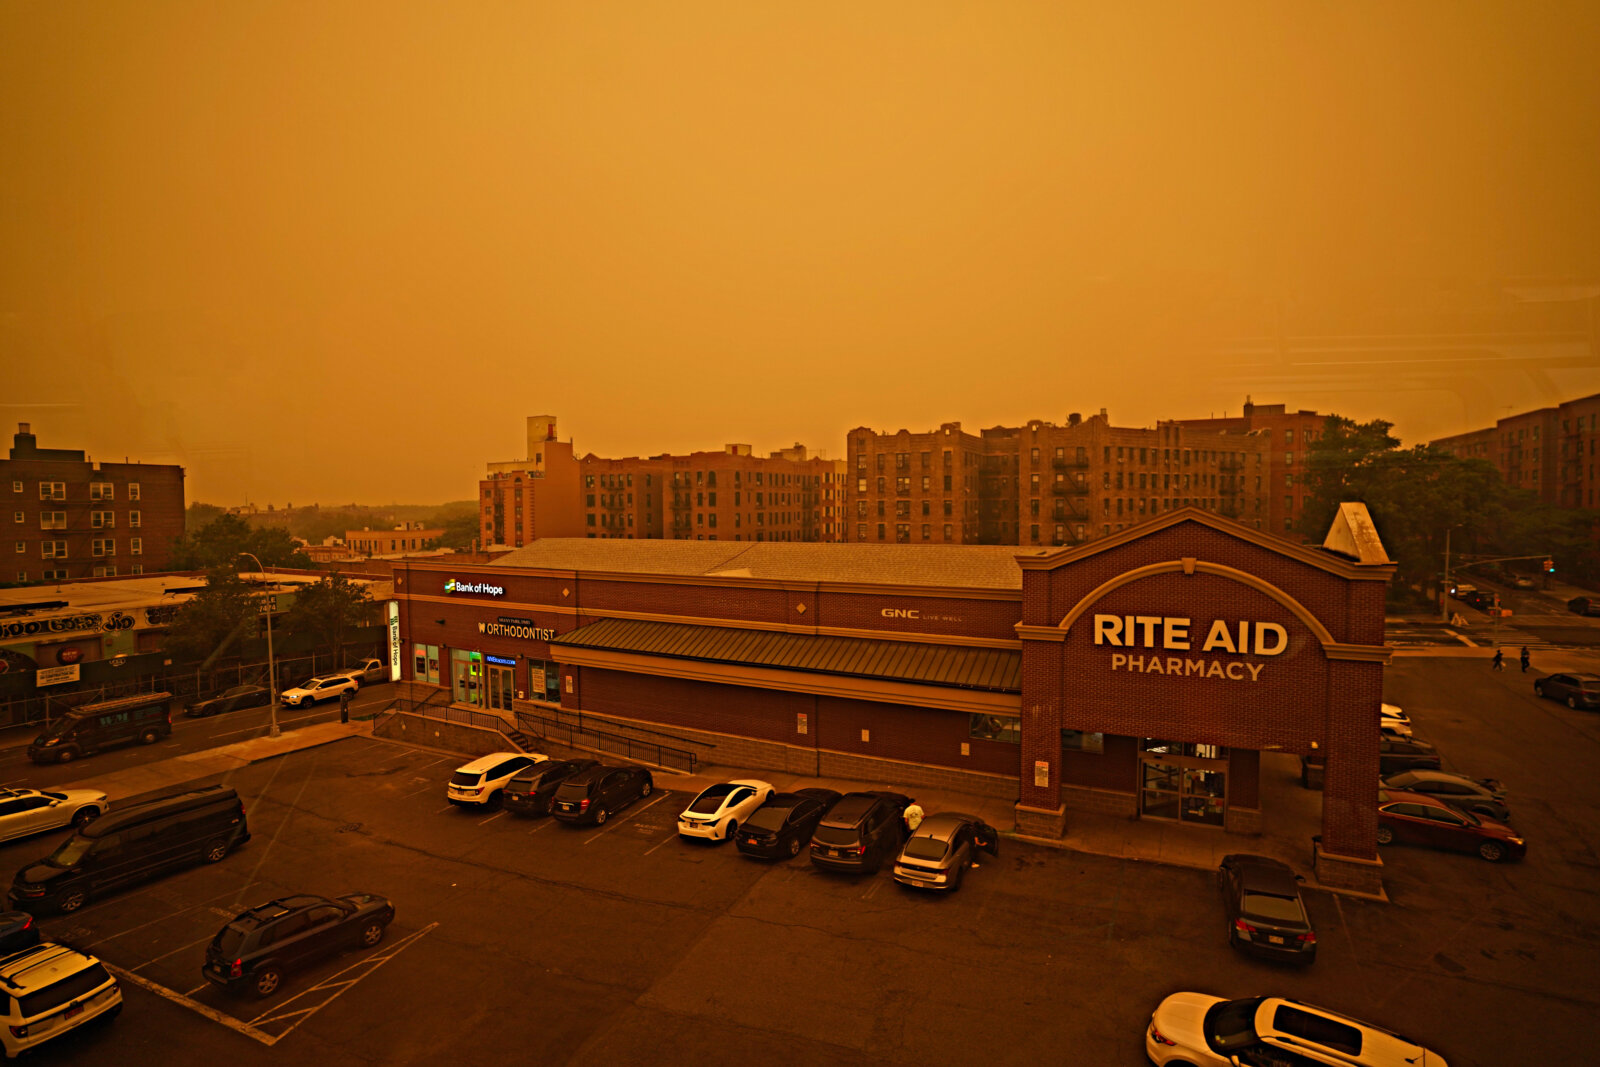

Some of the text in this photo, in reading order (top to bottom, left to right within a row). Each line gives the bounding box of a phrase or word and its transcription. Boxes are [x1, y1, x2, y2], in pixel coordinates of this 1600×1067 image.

[456, 581, 503, 596] Bank of Hope
[881, 608, 920, 619] GNC
[487, 623, 555, 641] ORTHODONTIST
[1094, 613, 1288, 656] RITE AID
[1112, 653, 1265, 681] PHARMACY
